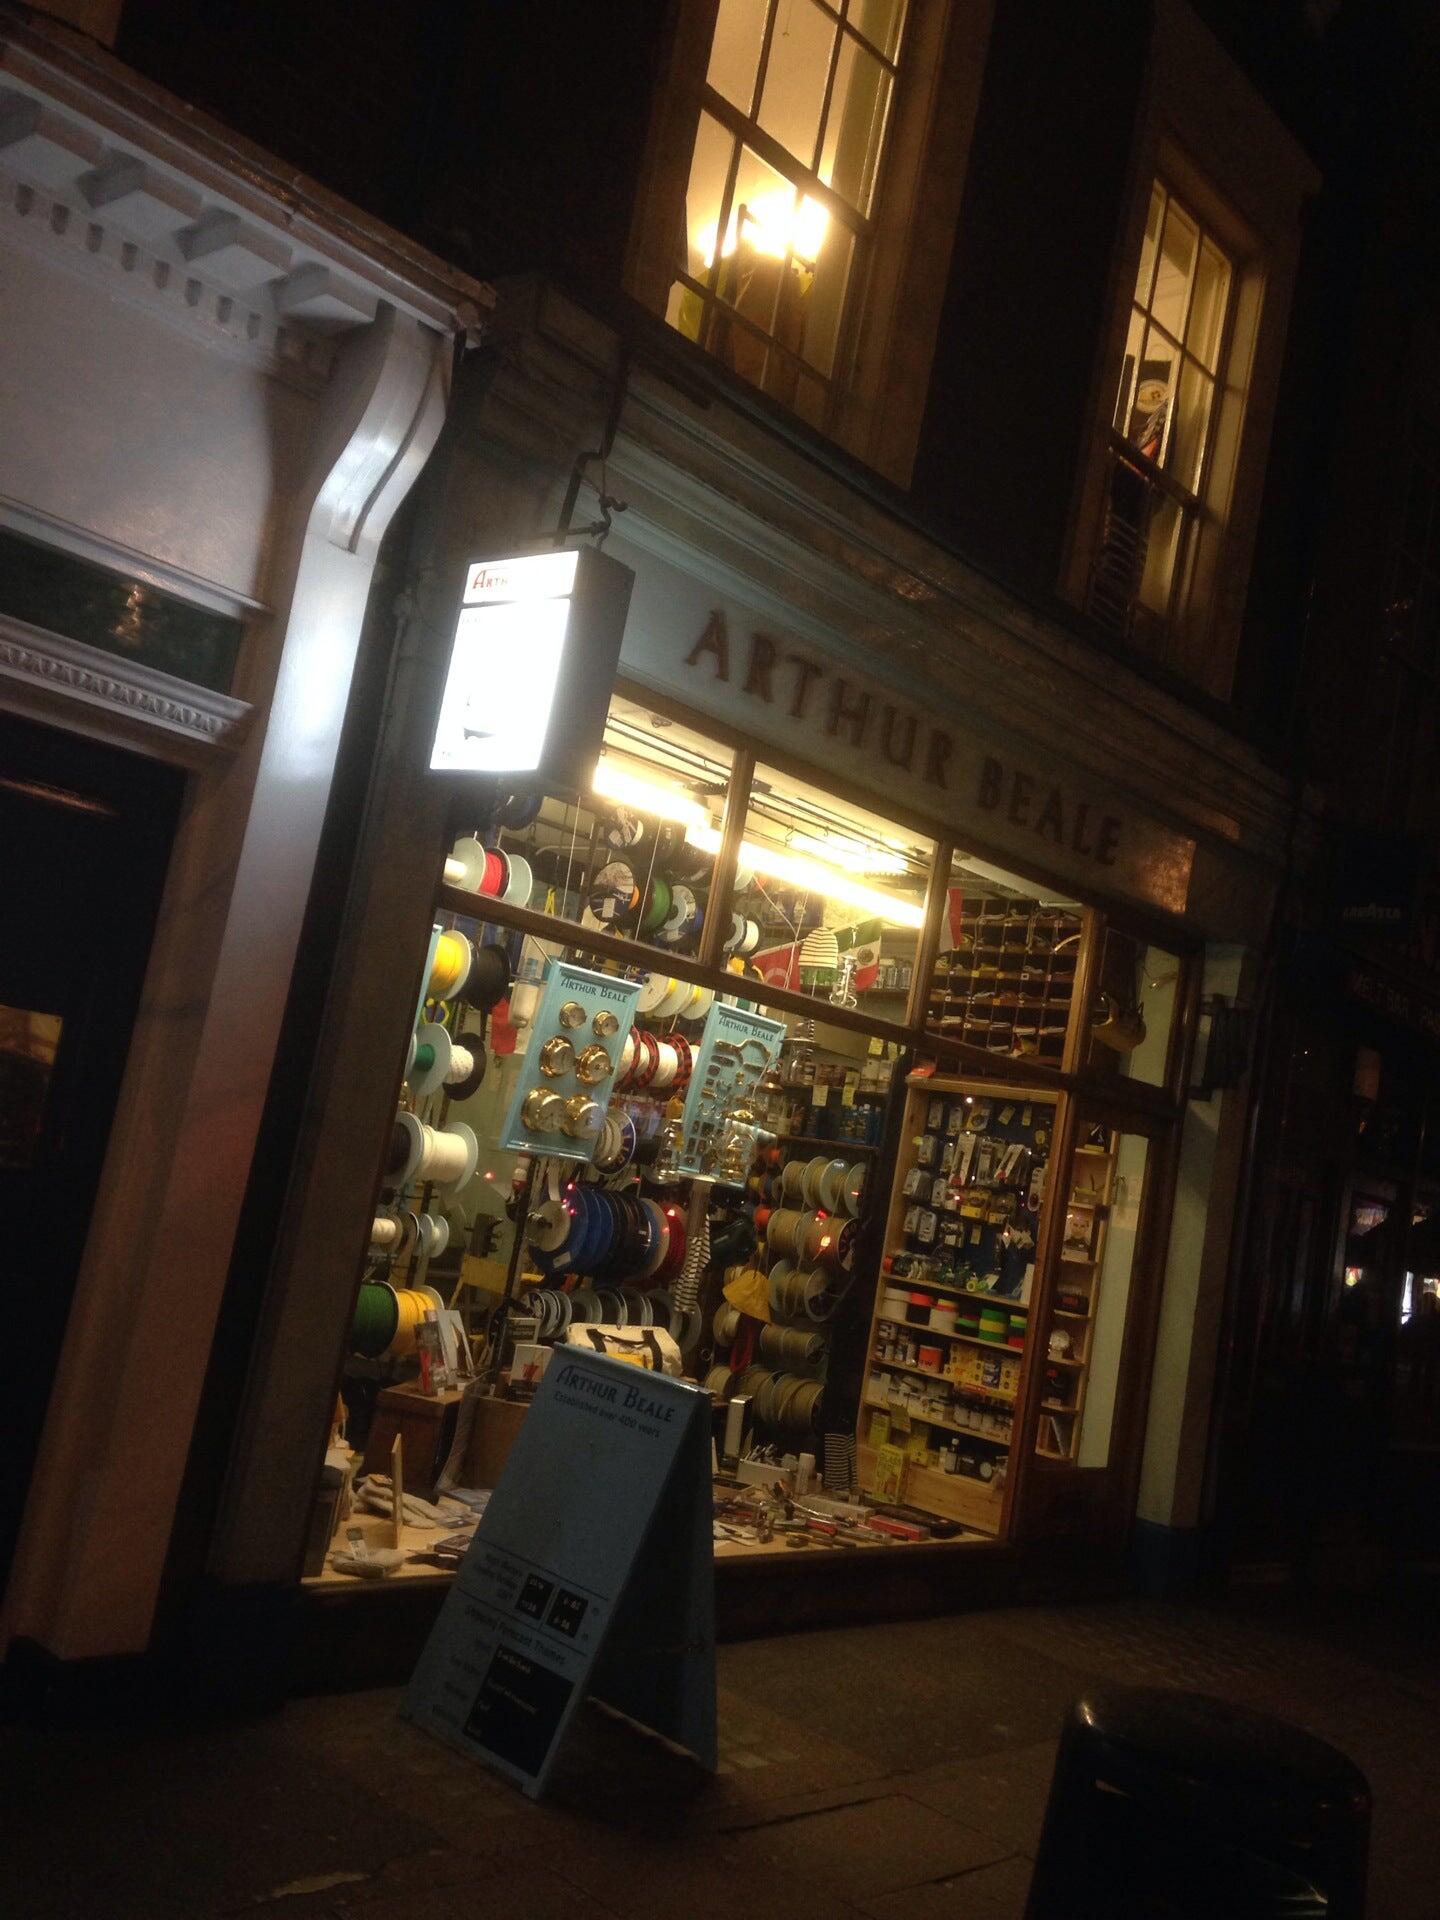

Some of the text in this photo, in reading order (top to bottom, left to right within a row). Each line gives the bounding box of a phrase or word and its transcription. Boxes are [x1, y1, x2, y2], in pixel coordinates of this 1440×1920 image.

[685, 608, 1121, 866] ARTHUR BEALE
[560, 977, 628, 1003] ARTHUR BEALE
[719, 1016, 774, 1042] ARTHUR BEALE
[553, 1391, 599, 1416] Established
[598, 1406, 618, 1422] over
[638, 1422, 661, 1438] years
[555, 1366, 675, 1423] ARTHUR BEALE
